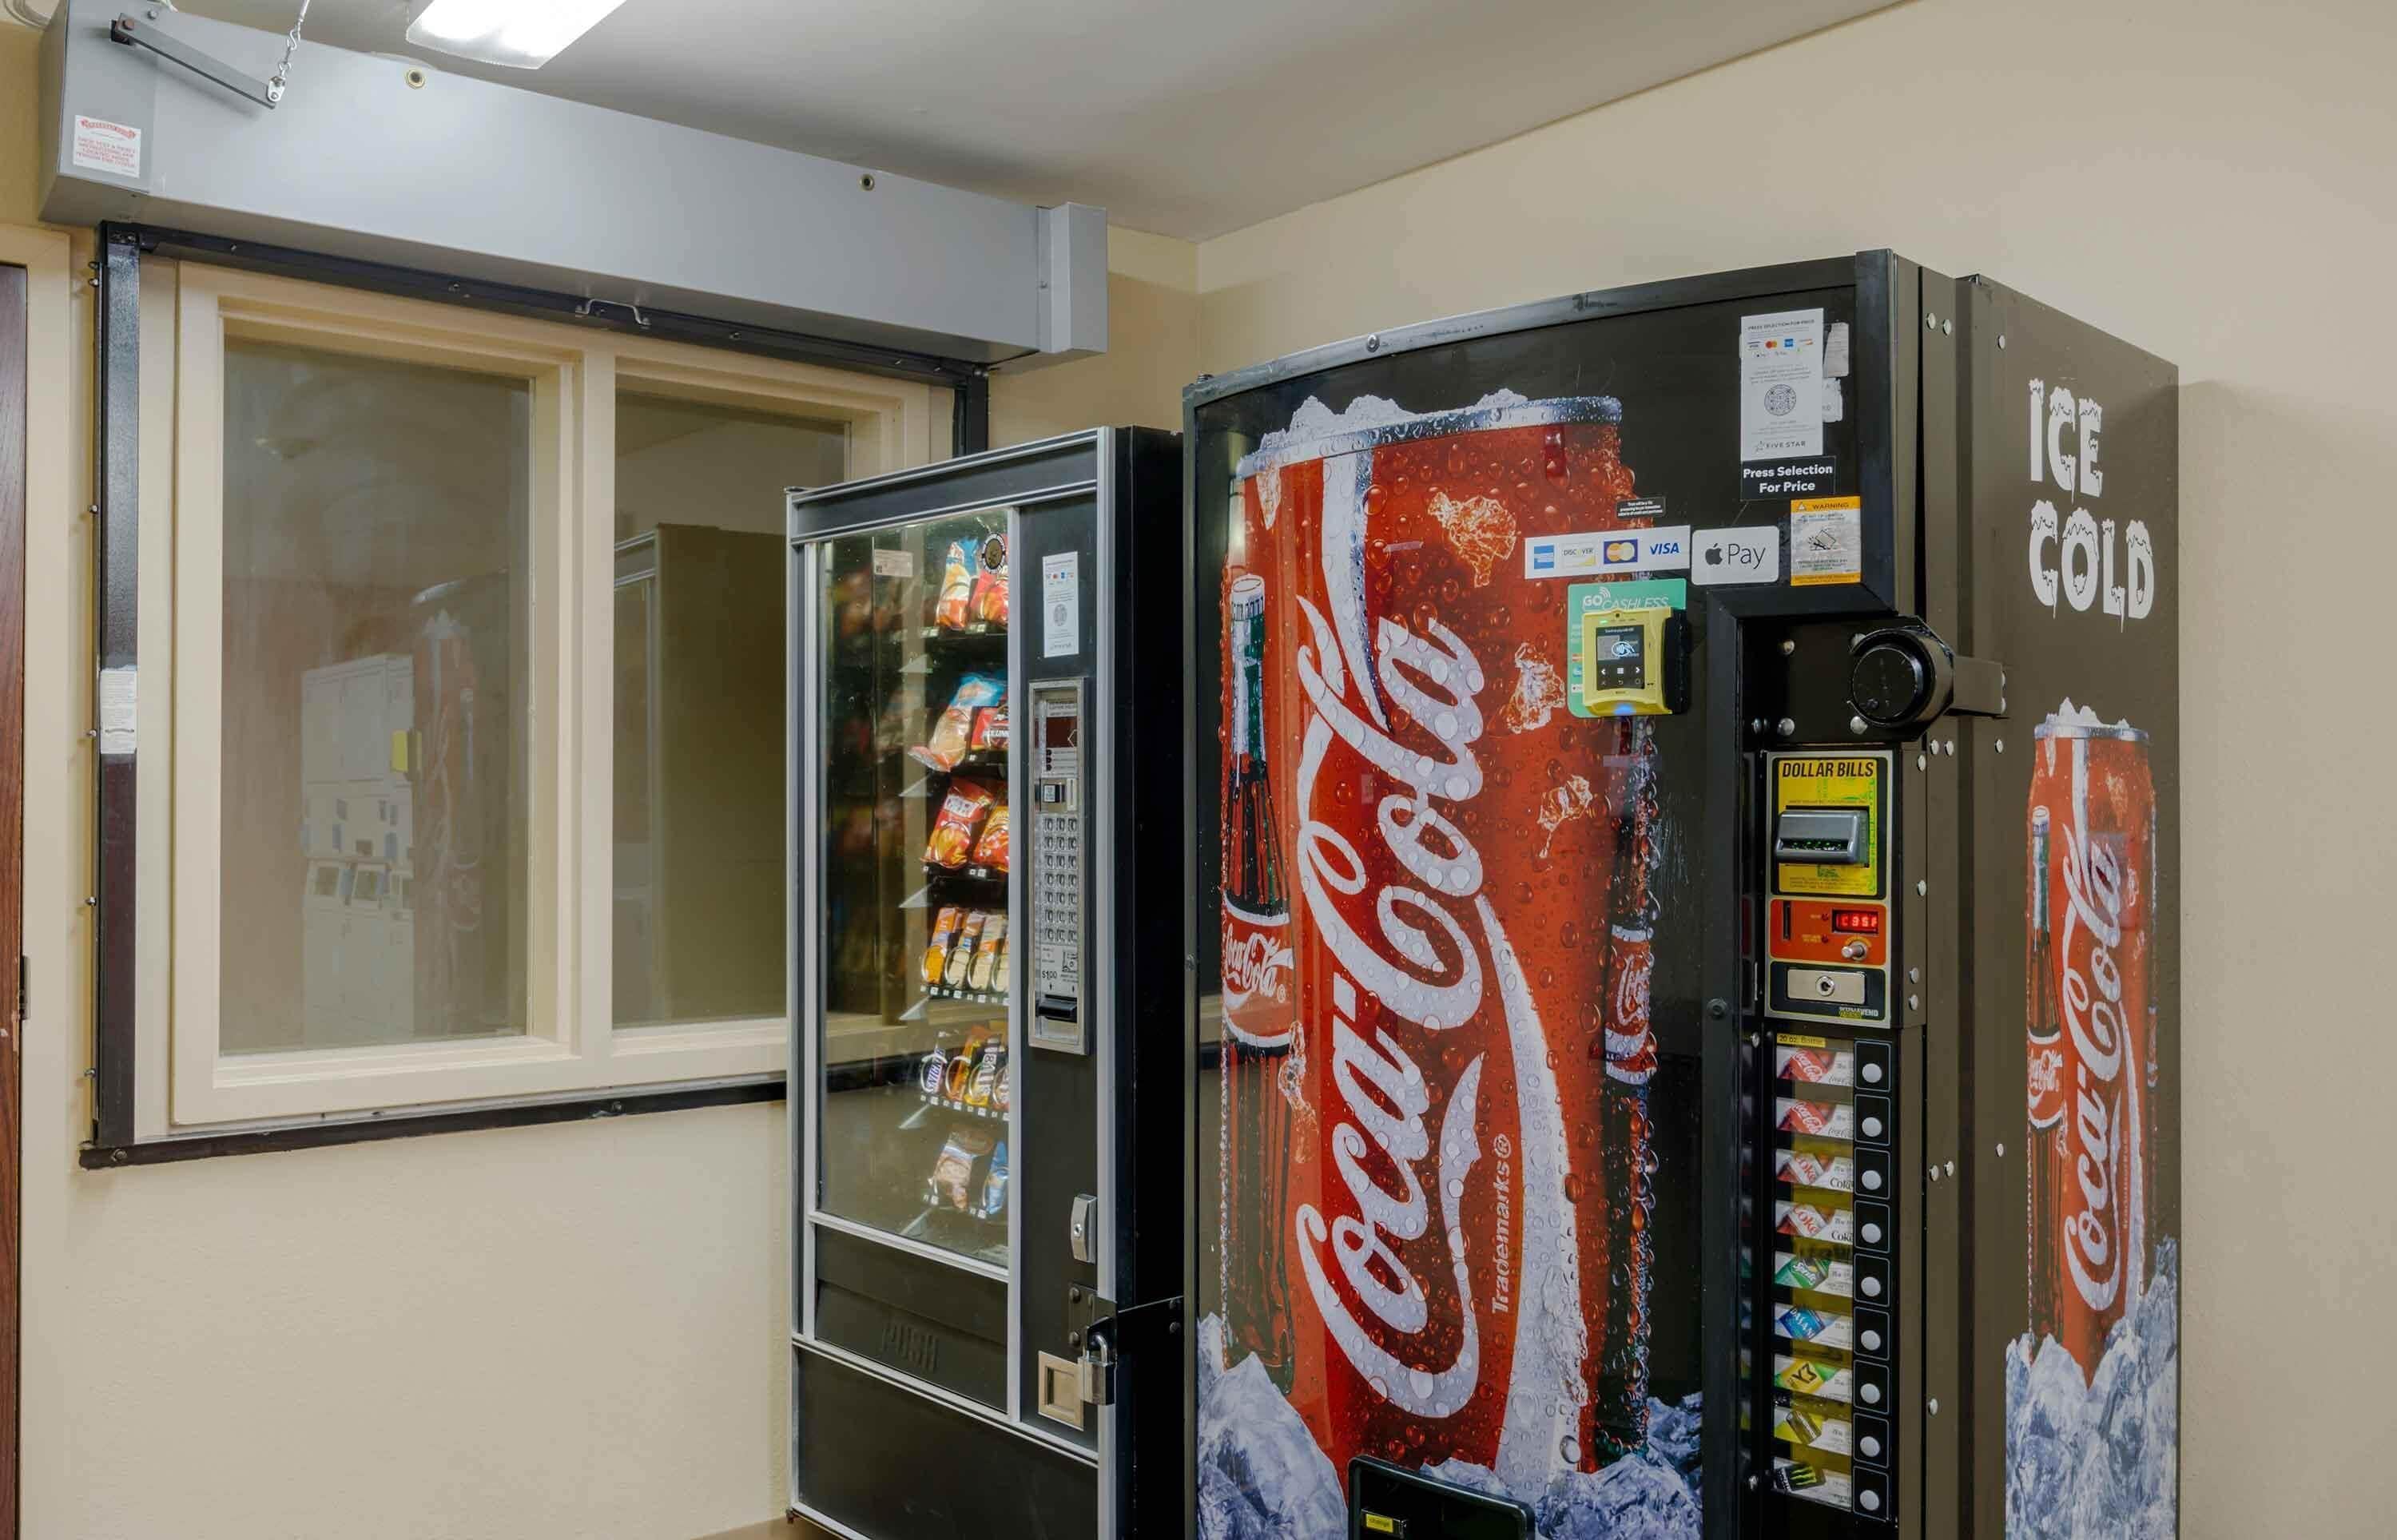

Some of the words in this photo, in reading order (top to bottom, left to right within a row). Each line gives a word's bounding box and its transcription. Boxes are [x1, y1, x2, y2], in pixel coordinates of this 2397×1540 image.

[2029, 378, 2103, 503] ICE
[1743, 468, 1775, 478] Press
[1777, 464, 1833, 477] Selection
[1759, 482, 1781, 493] For
[1783, 480, 1815, 492] Price
[1650, 542, 1679, 555] VISA
[1728, 543, 1767, 570] Pay
[2029, 499, 2155, 631] COLD
[1584, 594, 1603, 607] GO
[1602, 597, 1669, 609] CASHLESS
[1783, 762, 1834, 778] DOLLAR
[1837, 761, 1874, 777] BILLS
[1296, 593, 1485, 1419] Coca-Cola
[2063, 823, 2122, 1312] Coca-Cola
[882, 1321, 940, 1372] PUSH
